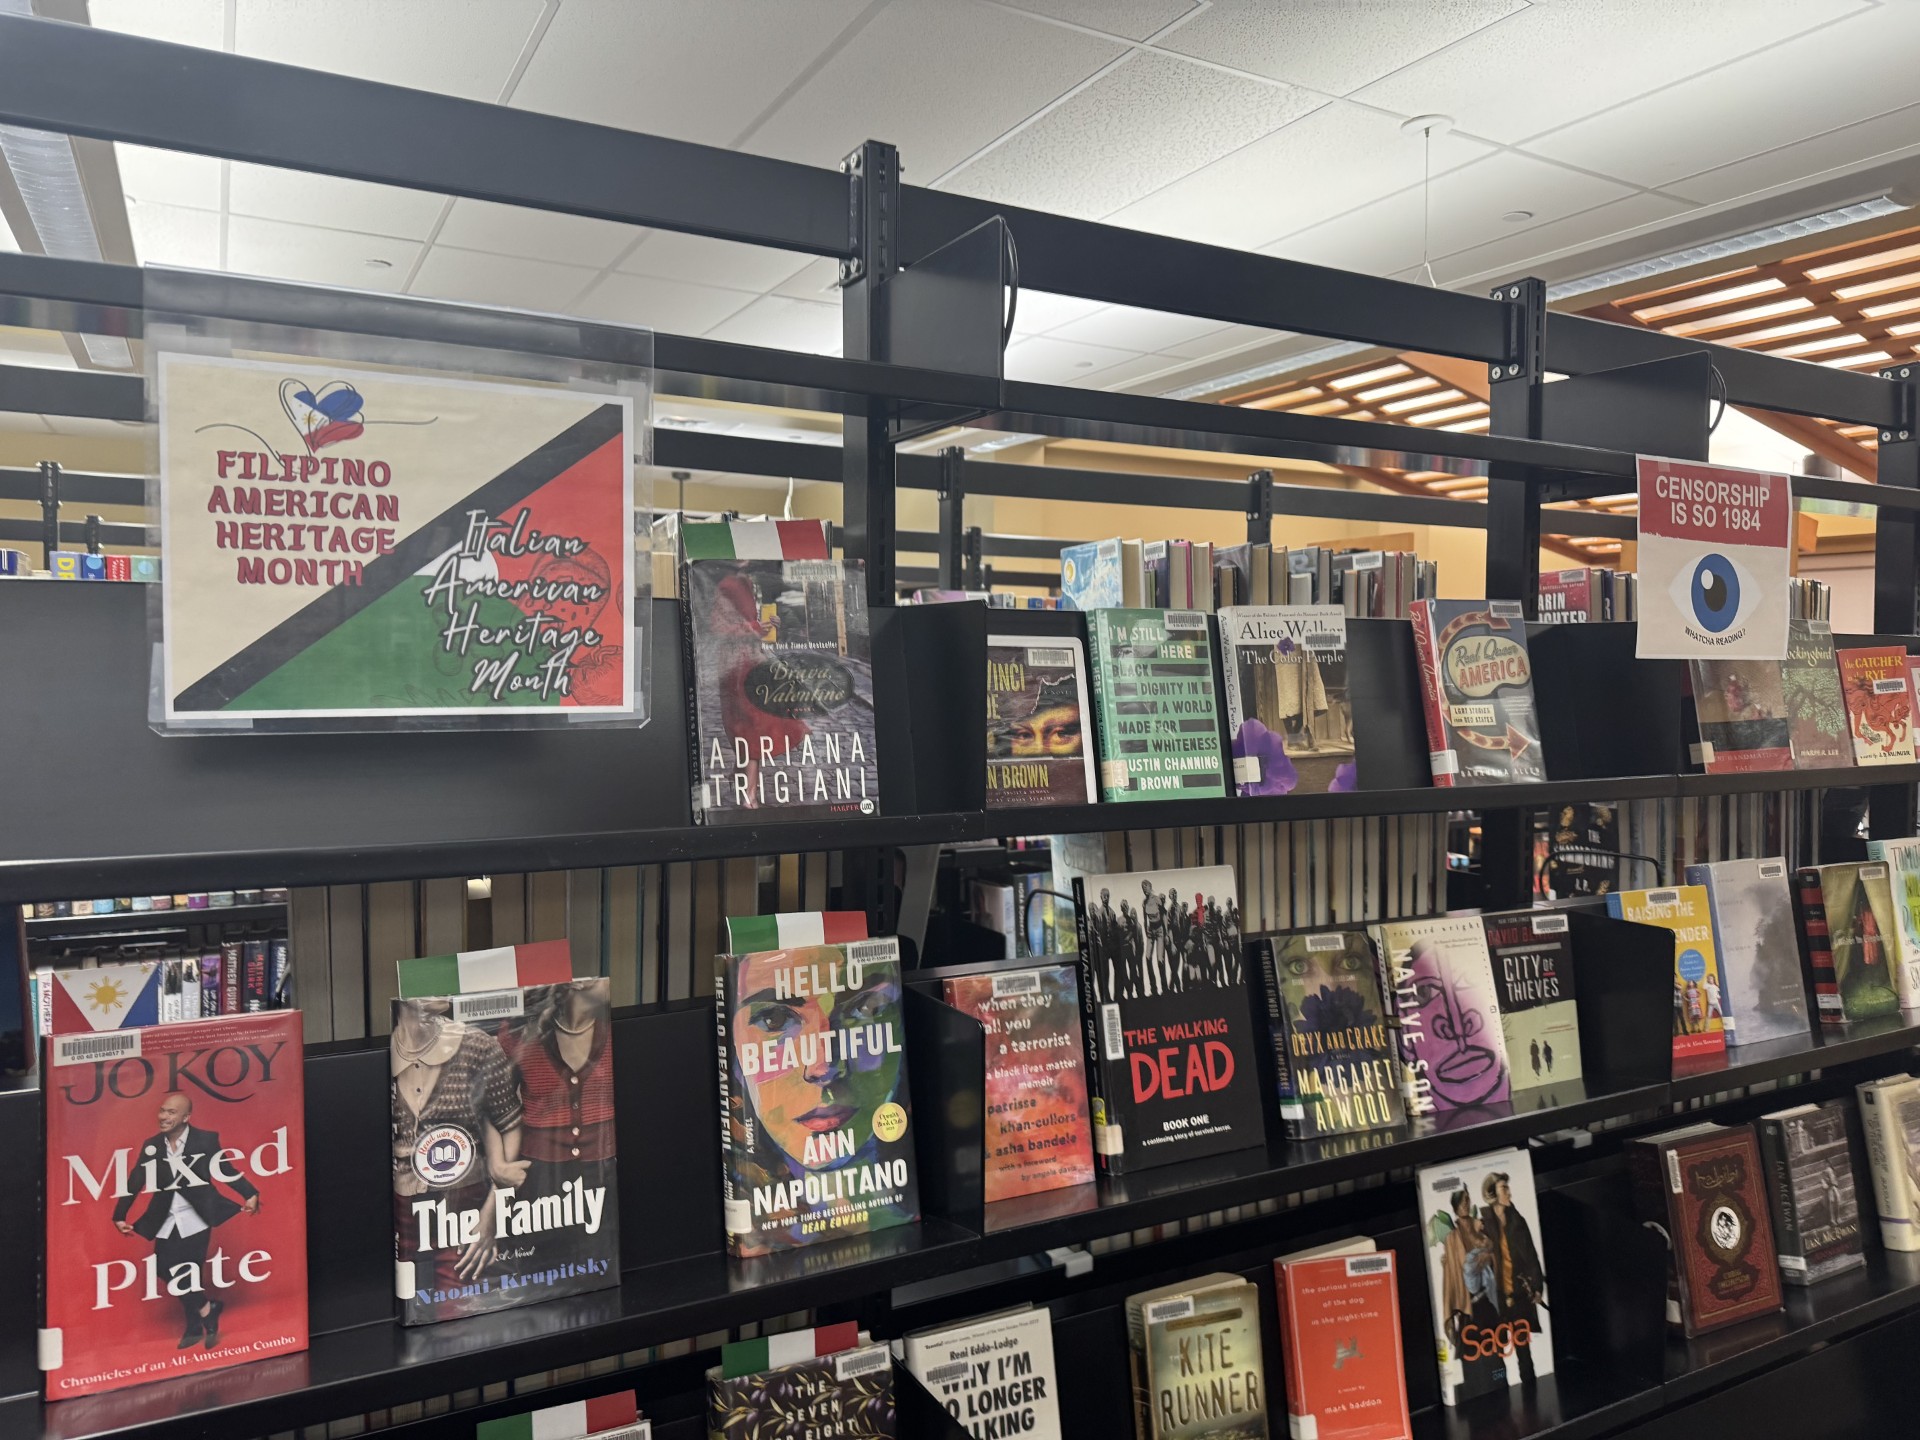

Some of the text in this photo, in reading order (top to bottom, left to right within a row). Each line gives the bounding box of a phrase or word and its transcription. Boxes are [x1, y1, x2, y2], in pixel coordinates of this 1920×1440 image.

[217, 450, 391, 487] FILIPINO
[208, 485, 399, 522] AMERICAN
[1655, 475, 1770, 508] CENSORSHIP
[1671, 504, 1761, 532] IS SO 1984
[216, 521, 396, 555] HERITAGE
[461, 509, 584, 560] Italian
[237, 556, 364, 587] MONTH
[424, 556, 603, 614] American
[444, 602, 601, 655] Heritage
[1109, 625, 1164, 641] I'M STILL
[1240, 621, 1283, 639] Alice
[1685, 626, 1746, 646] WHATCHA READING?
[1160, 645, 1192, 659] HERE
[1242, 650, 1343, 665] The Color Purple
[1786, 646, 1832, 667] ockingbird
[1844, 656, 1903, 669] the CATCHER
[471, 650, 571, 699] Month
[1113, 664, 1149, 678] BLACK
[1459, 656, 1528, 688] AMERICA
[1865, 670, 1887, 680] RYE
[1141, 682, 1198, 696] DIGNITY IN
[1162, 700, 1212, 714] A WORLD
[1118, 720, 1177, 734] MADE FOR
[710, 731, 866, 770] ADRIANA
[1152, 737, 1217, 751] WHITENESS
[1002, 764, 1049, 788] BROWN
[1165, 756, 1219, 770] CHANNING
[710, 767, 867, 806] TRIGIANI
[1140, 776, 1180, 790] BROWN
[1627, 902, 1695, 922] RAISING THE
[1393, 922, 1480, 937] richard wright
[1488, 927, 1518, 945] DAVID
[774, 962, 863, 1000] HELLO
[1503, 954, 1554, 982] CITY OF
[1077, 914, 1098, 1061] THE WALKING DEAD
[1506, 977, 1559, 1004] THIEVES
[978, 993, 1052, 1012] when they
[985, 1018, 1031, 1035] all you
[1124, 1018, 1228, 1048] THE WALKING
[1394, 948, 1436, 1113] NATIVE SON
[743, 1022, 902, 1076] BEAUTIFUL
[1000, 1032, 1071, 1054] a terrorist
[1291, 1024, 1387, 1057] ORYX AND CRAKE
[59, 1041, 288, 1105] JO KOY
[715, 976, 732, 1154] HELLO BEAUTIFUL
[994, 1066, 1020, 1079] black
[1022, 1064, 1044, 1074] lives
[1046, 1059, 1077, 1071] matter
[1129, 1041, 1235, 1104] DEAD
[1297, 1059, 1395, 1098] MARGARET
[1018, 1076, 1054, 1089] memoir
[987, 1098, 1037, 1118] patrisse
[1315, 1091, 1391, 1131] ATWOOD
[1000, 1113, 1076, 1134] khan-cullors
[1163, 1114, 1210, 1131] BOOK ONE
[803, 1128, 855, 1165] ANN
[996, 1143, 1025, 1157] asha
[1028, 1133, 1077, 1151] bandele
[62, 1125, 292, 1206] Mixed
[1777, 1161, 1786, 1179] IAN
[753, 1159, 908, 1216] NAPOLITANO
[412, 1176, 606, 1252] The Family
[761, 1194, 904, 1231] NEW YORK TIMES BESTSELLING AUTHOR OF
[802, 1211, 869, 1235] DEAR EDWARD
[91, 1246, 271, 1310] Plate
[415, 1257, 611, 1306] Naomi Krupitsky
[1317, 1284, 1347, 1292] curious
[1349, 1296, 1365, 1305] dog
[971, 1336, 1019, 1356] Eddo-Lodge
[1179, 1328, 1234, 1377] KITE
[1461, 1318, 1532, 1362] Saga
[60, 1335, 296, 1389] Chronicles of an All-American Combo
[998, 1351, 1032, 1380] I'M
[795, 1380, 826, 1399] THE
[967, 1377, 1047, 1418] LONGER
[1160, 1371, 1259, 1432] RUNNER
[786, 1400, 839, 1426] SEVEN
[1325, 1404, 1347, 1414] mark
[805, 1418, 856, 1440] EIGHT
